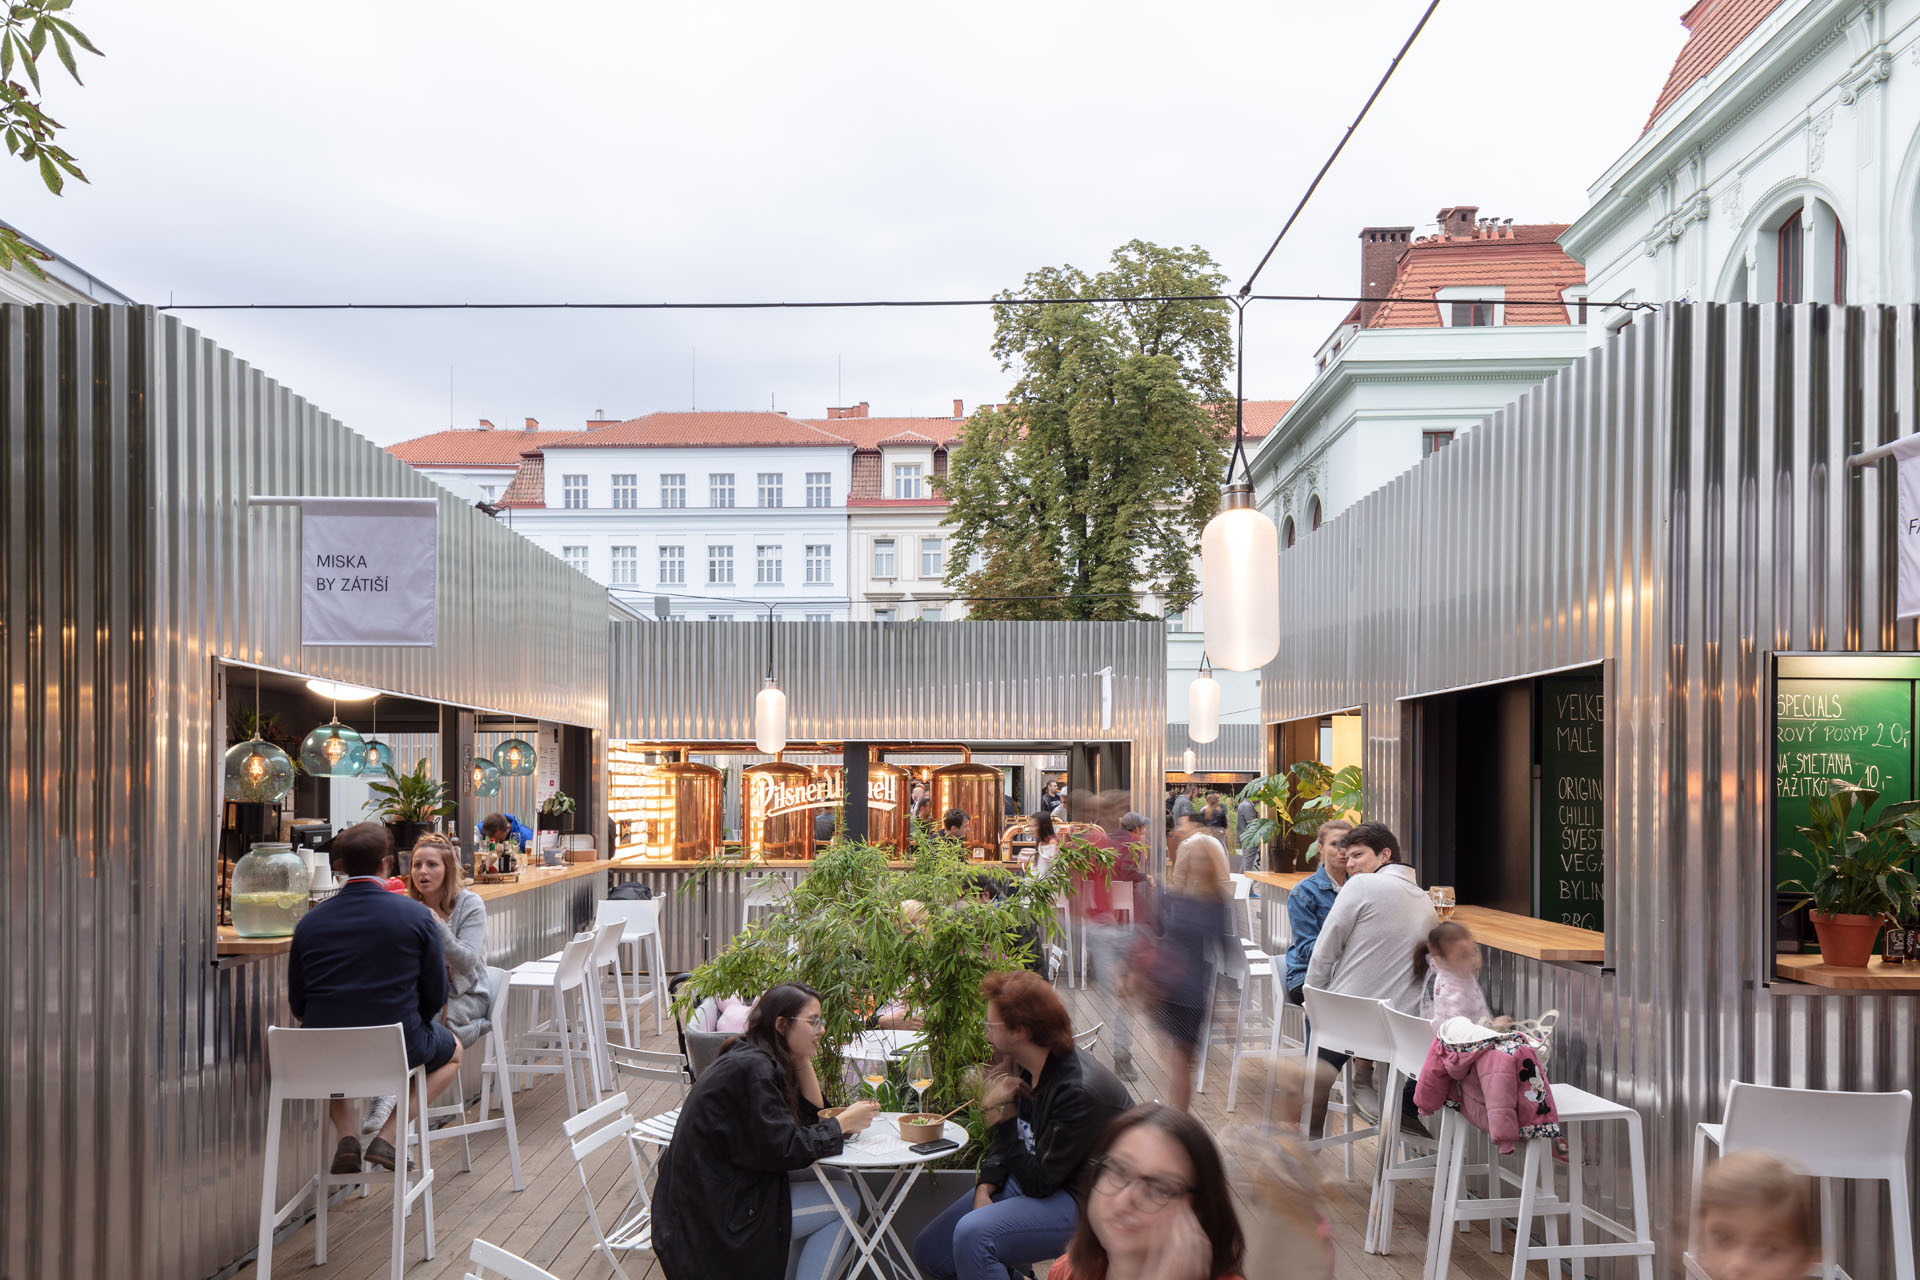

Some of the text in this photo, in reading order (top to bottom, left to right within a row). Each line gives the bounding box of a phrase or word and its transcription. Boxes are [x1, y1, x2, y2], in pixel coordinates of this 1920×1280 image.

[316, 554, 368, 569] MISKA
[316, 575, 389, 593] BY ZÁTIŠÍ
[1777, 694, 1842, 719] SPECIALS
[1556, 722, 1597, 752] MALÉ
[1823, 725, 1869, 742] POSYP
[751, 771, 825, 822] Pilsner
[1558, 776, 1603, 801] ORIGIN
[1558, 805, 1595, 826] CHILLI
